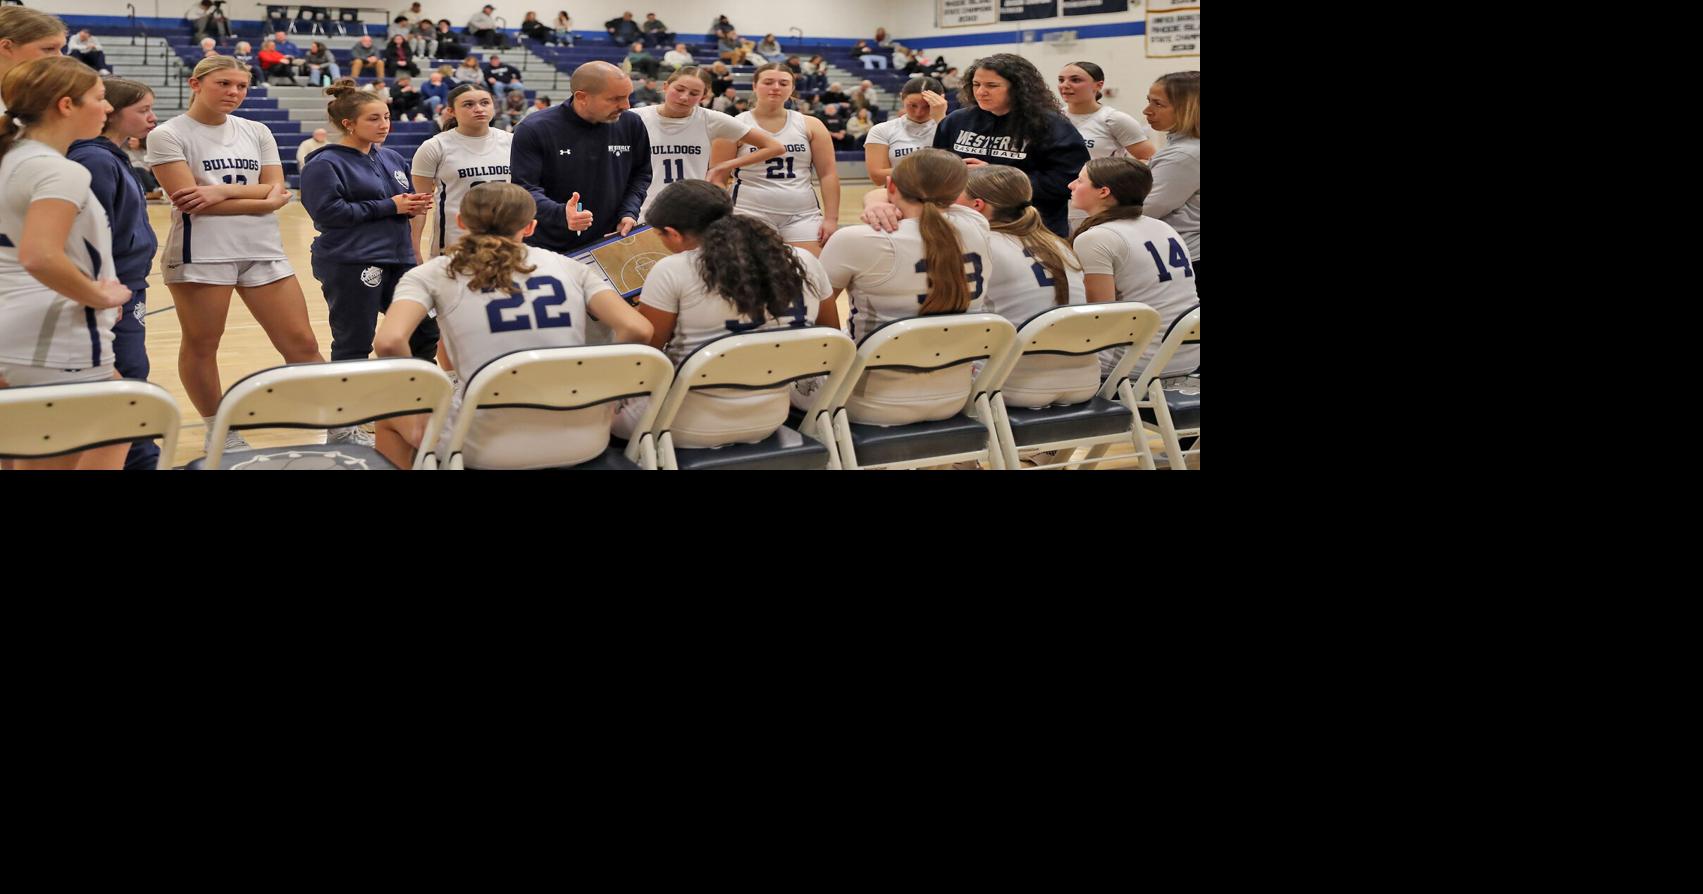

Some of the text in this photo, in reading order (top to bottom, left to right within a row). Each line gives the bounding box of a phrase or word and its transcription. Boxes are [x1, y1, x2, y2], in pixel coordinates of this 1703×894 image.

[651, 145, 702, 155] ULLDOGS
[954, 144, 1027, 159] BASKEBALL
[202, 158, 259, 171] BULLDOGS
[663, 159, 684, 183] 11
[765, 157, 796, 179] 21
[1144, 237, 1193, 283] 14
[486, 275, 572, 333] 22
